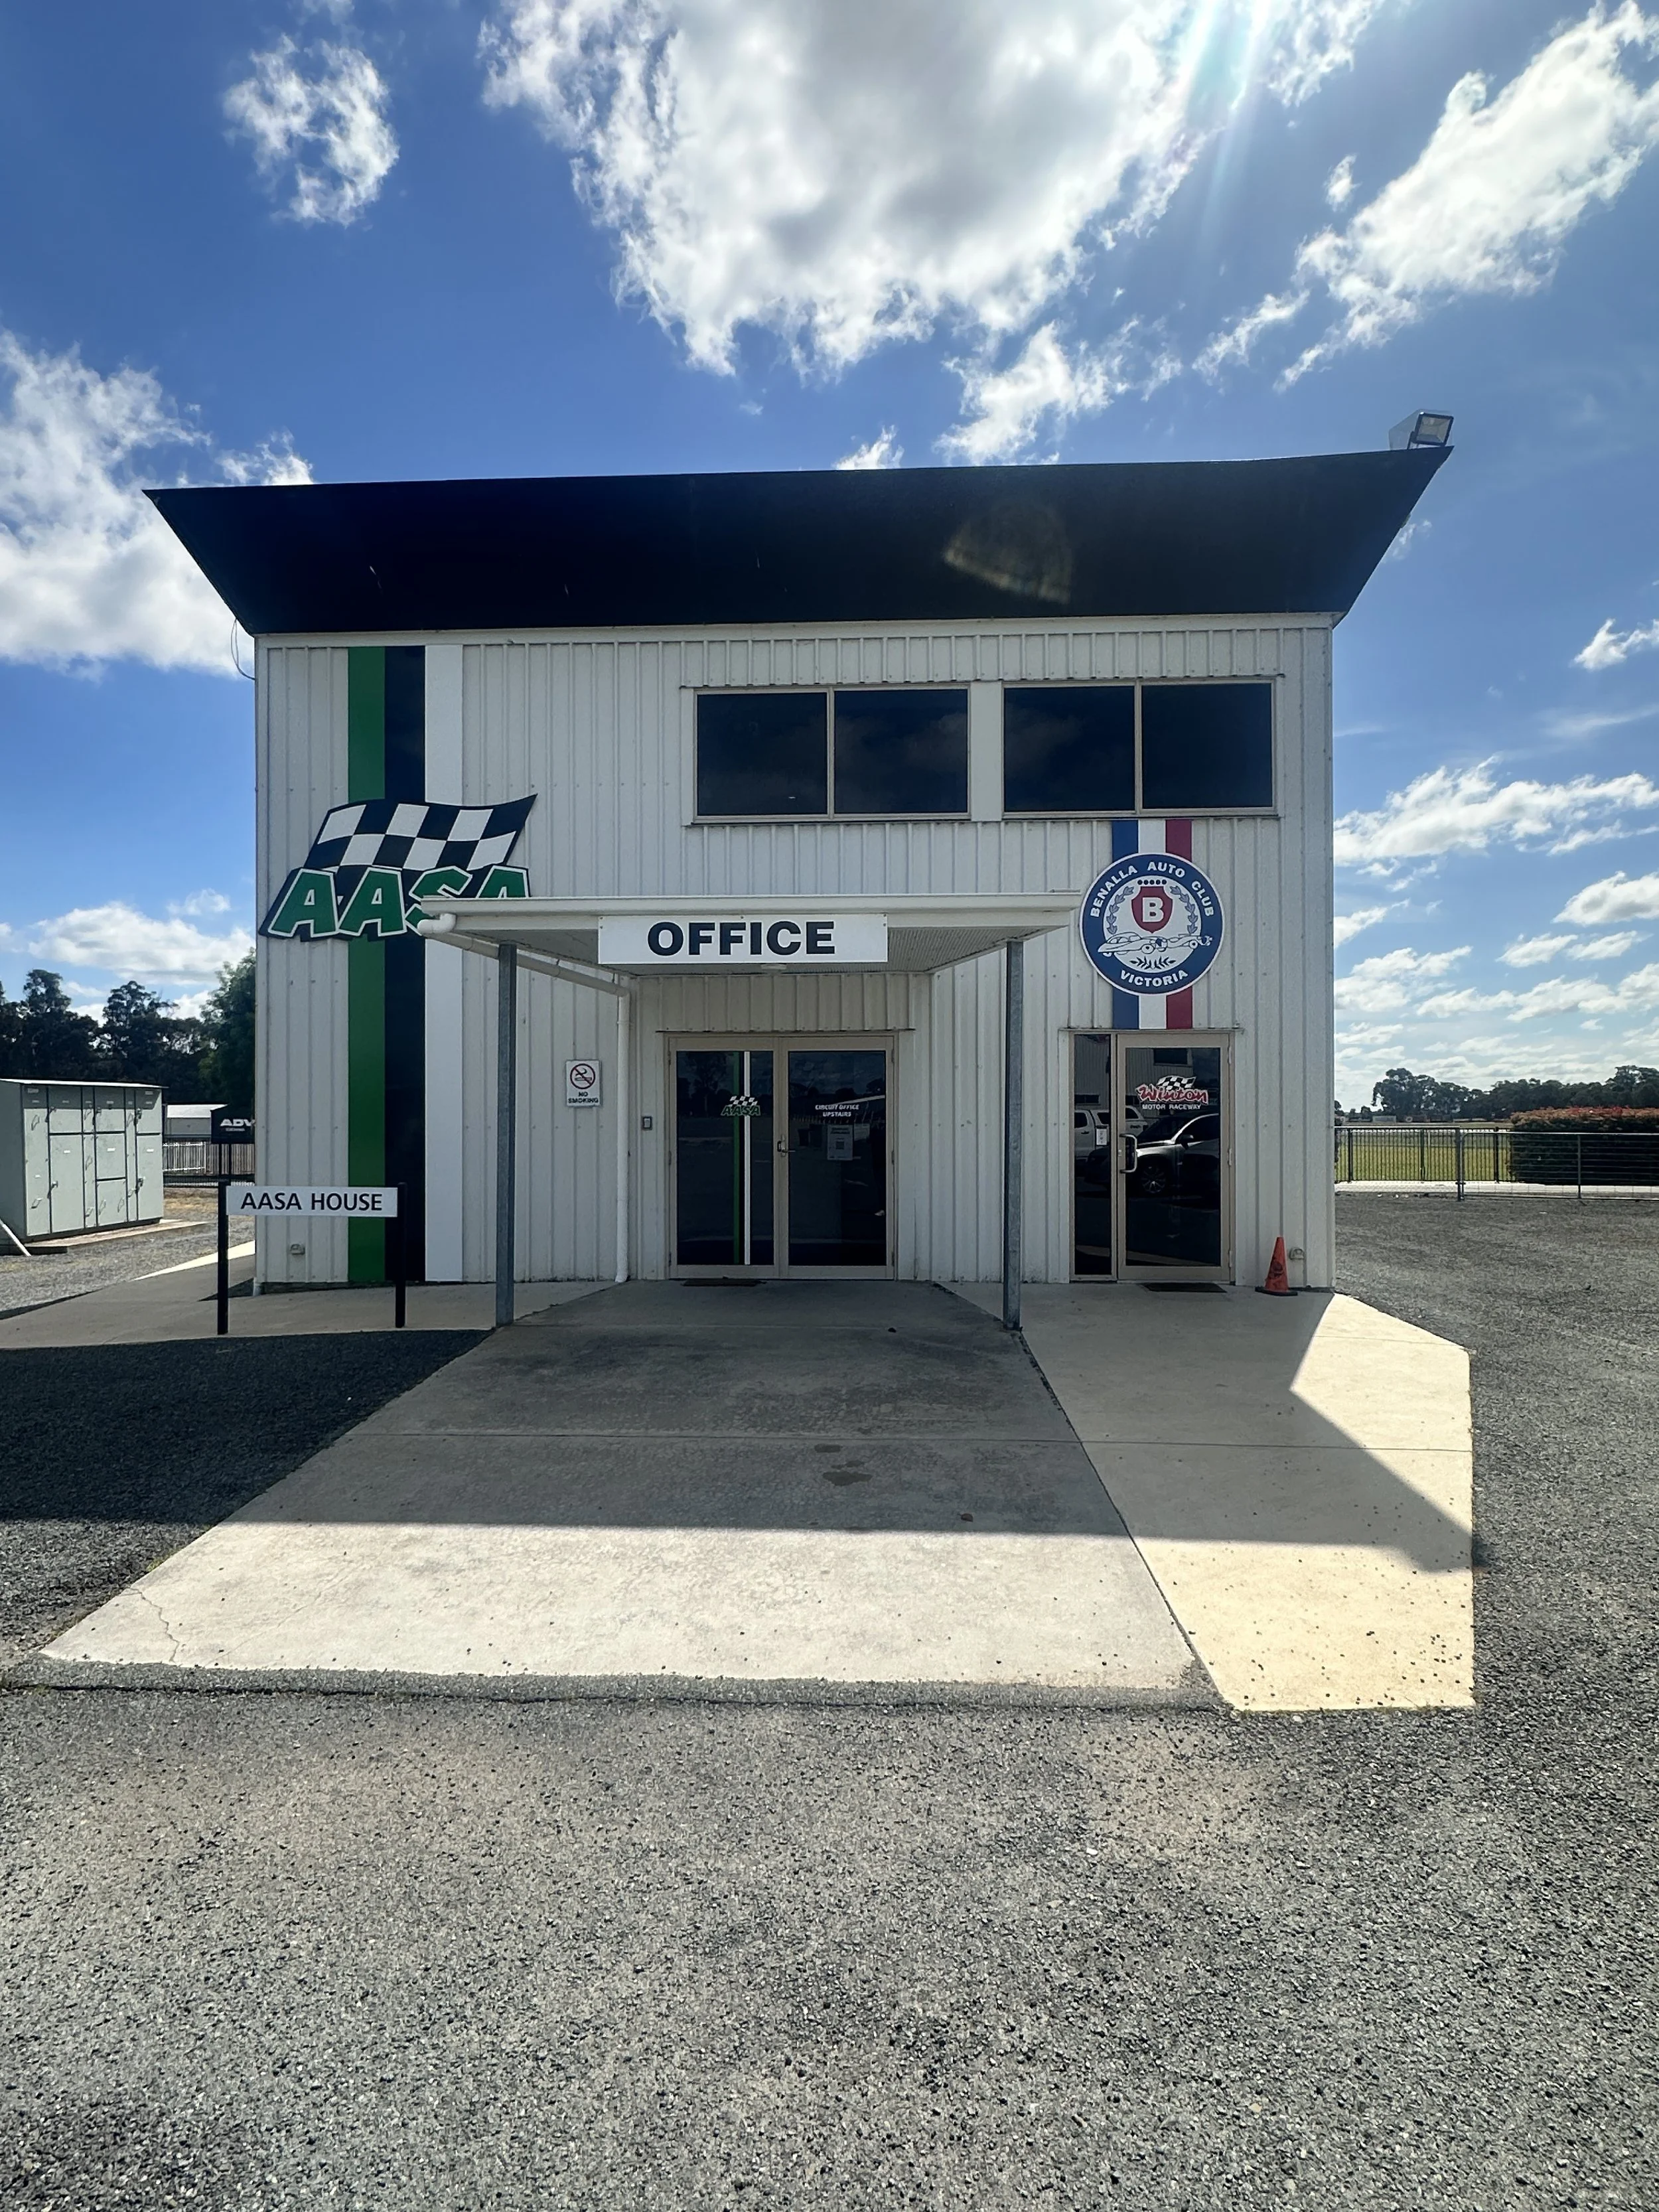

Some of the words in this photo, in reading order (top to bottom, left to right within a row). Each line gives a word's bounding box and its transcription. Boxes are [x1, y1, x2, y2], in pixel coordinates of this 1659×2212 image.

[1090, 865, 1137, 917] BENALLA
[1147, 861, 1185, 877] AUTO
[1191, 881, 1214, 917] CLUB
[1142, 897, 1164, 922] B
[647, 921, 835, 956] OFFICE
[1119, 970, 1188, 987] VICTORIA
[1135, 1084, 1208, 1104] Winton
[720, 1104, 761, 1116] AASA
[240, 1193, 302, 1211] AASA
[311, 1193, 382, 1211] HOUSE
